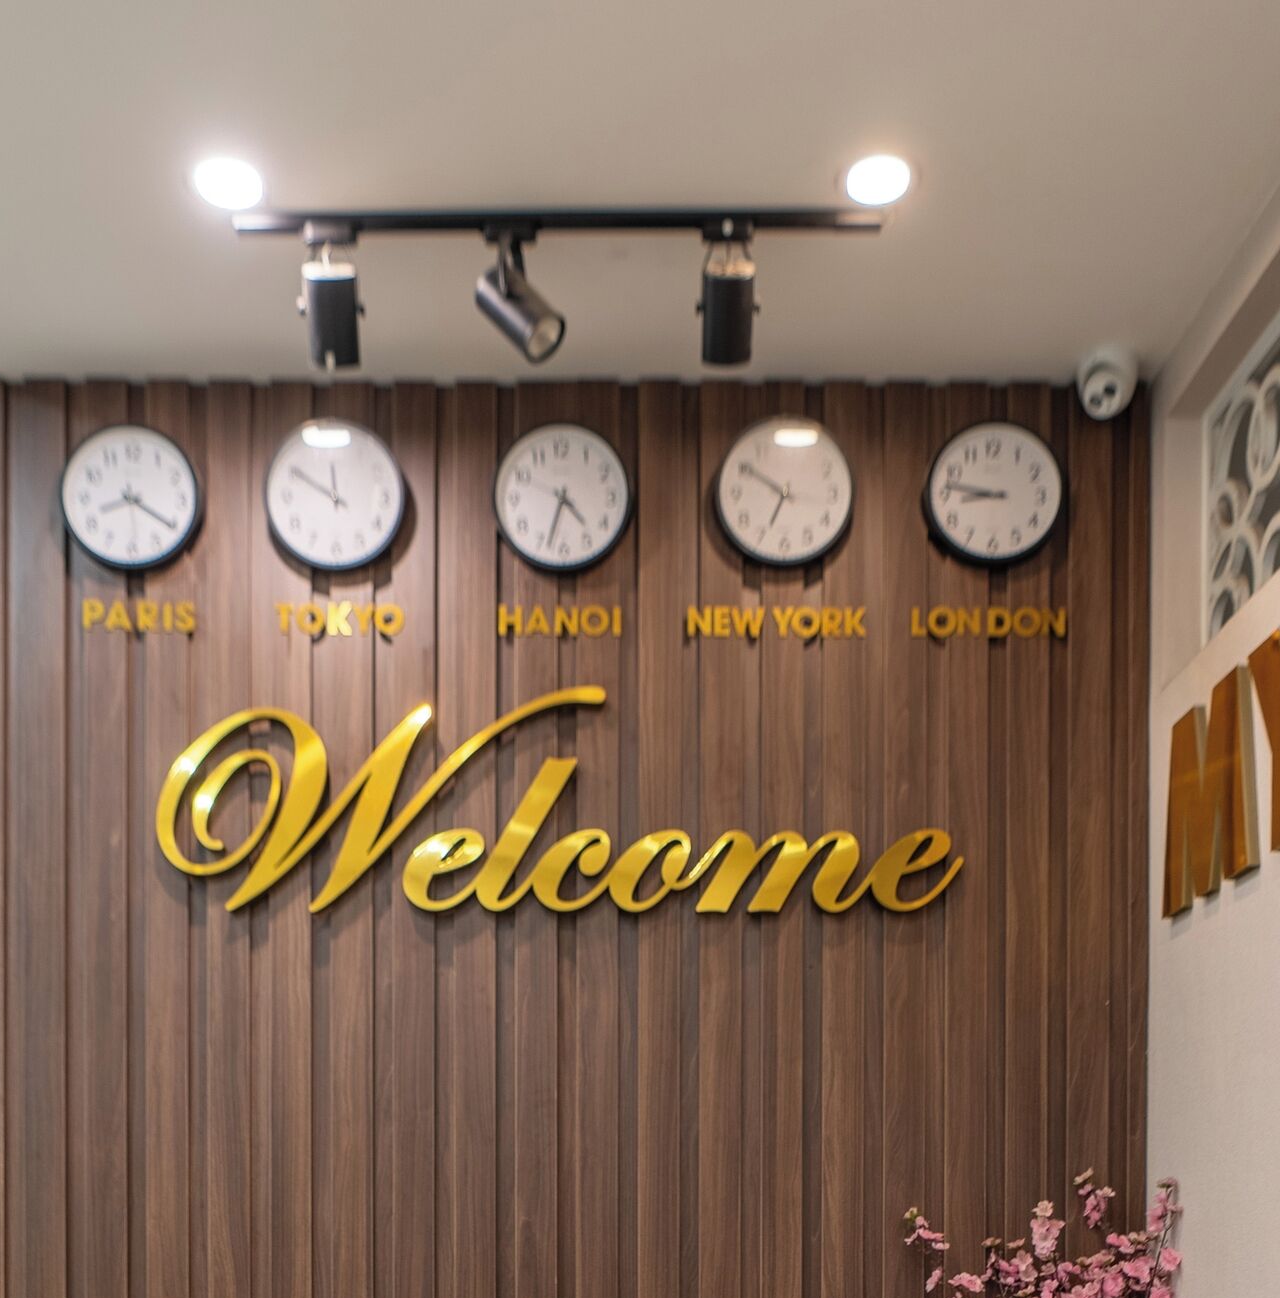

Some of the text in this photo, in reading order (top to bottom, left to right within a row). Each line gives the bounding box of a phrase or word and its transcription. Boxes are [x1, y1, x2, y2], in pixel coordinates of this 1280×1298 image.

[82, 600, 196, 632] PARIS
[275, 601, 406, 637] TOKYO
[497, 606, 622, 637] HANOI
[686, 605, 867, 638] NEW YORK
[911, 606, 1067, 638] LONDON
[156, 685, 964, 914] Welcome
